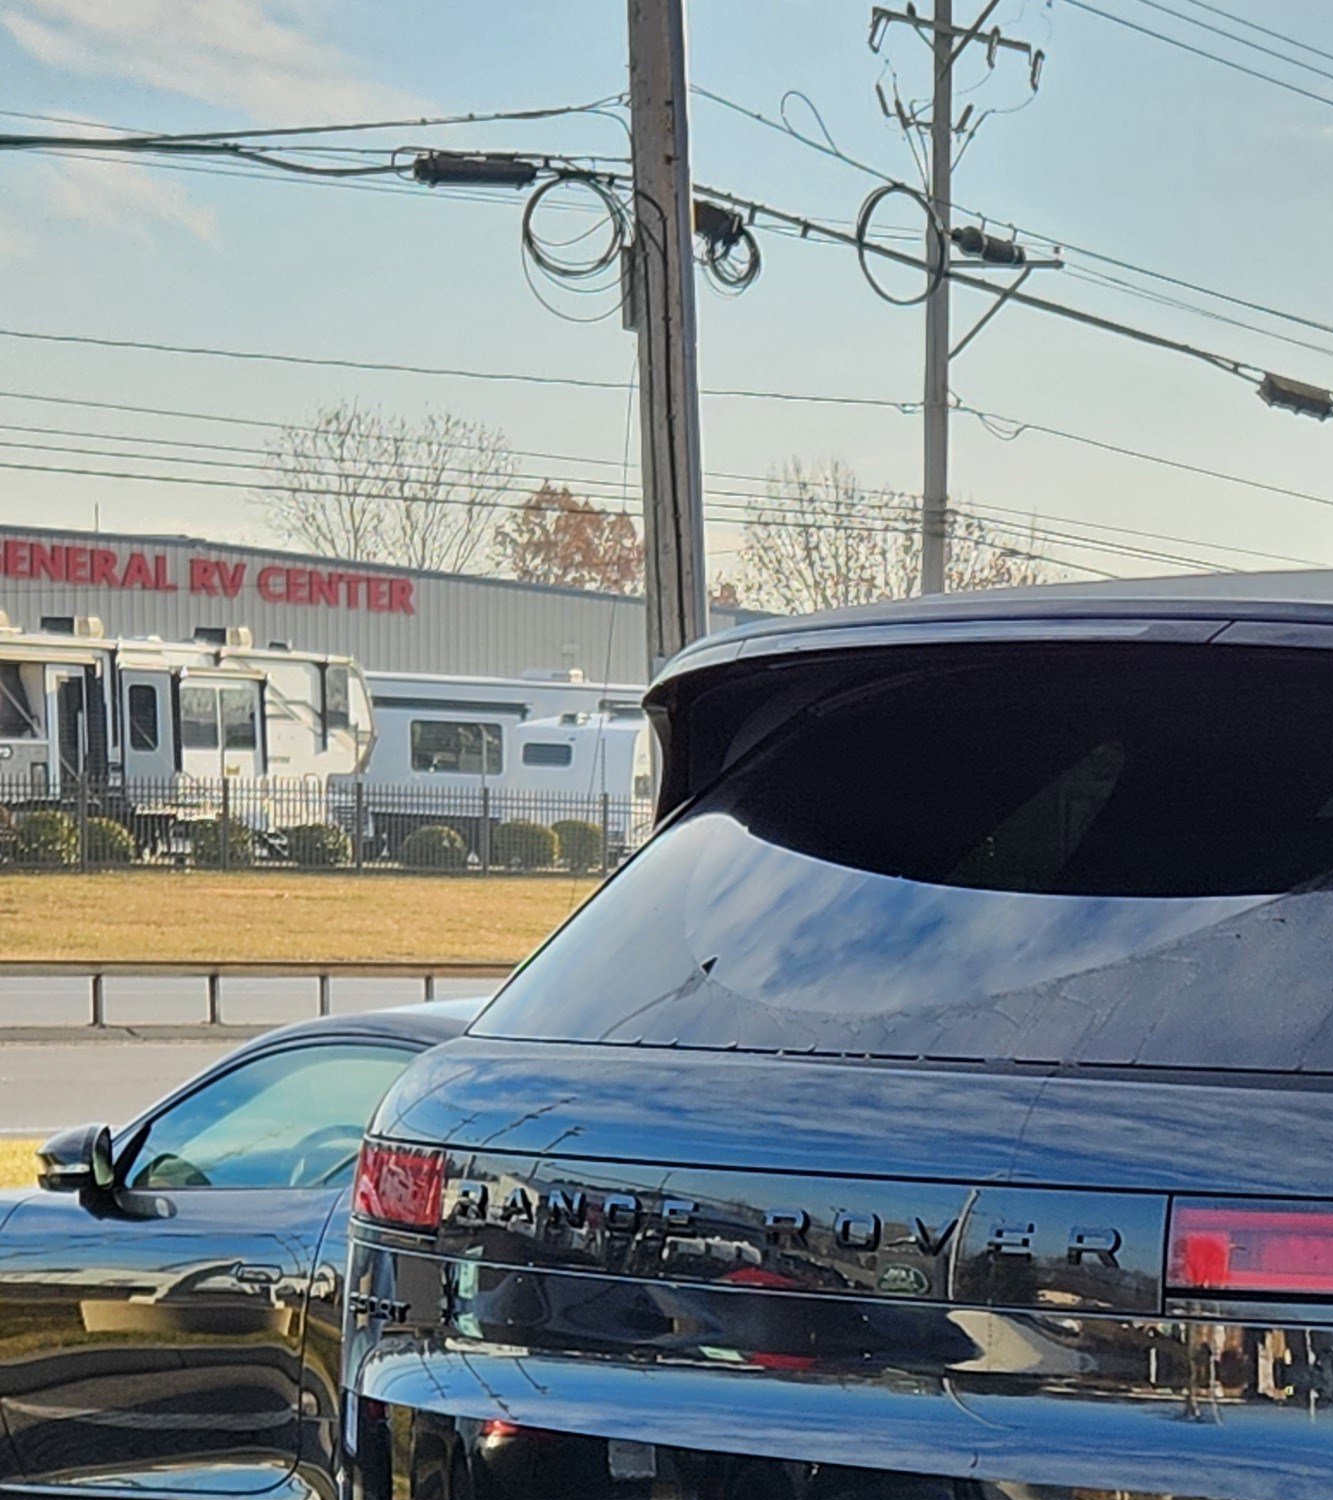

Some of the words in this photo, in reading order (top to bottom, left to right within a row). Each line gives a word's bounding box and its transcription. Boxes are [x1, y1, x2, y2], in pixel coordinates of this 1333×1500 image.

[0, 539, 179, 592] ENERAL
[189, 557, 247, 600] RV
[256, 565, 416, 616] CENTER
[452, 1182, 700, 1239] RANGE
[764, 1207, 1123, 1269] ROVER
